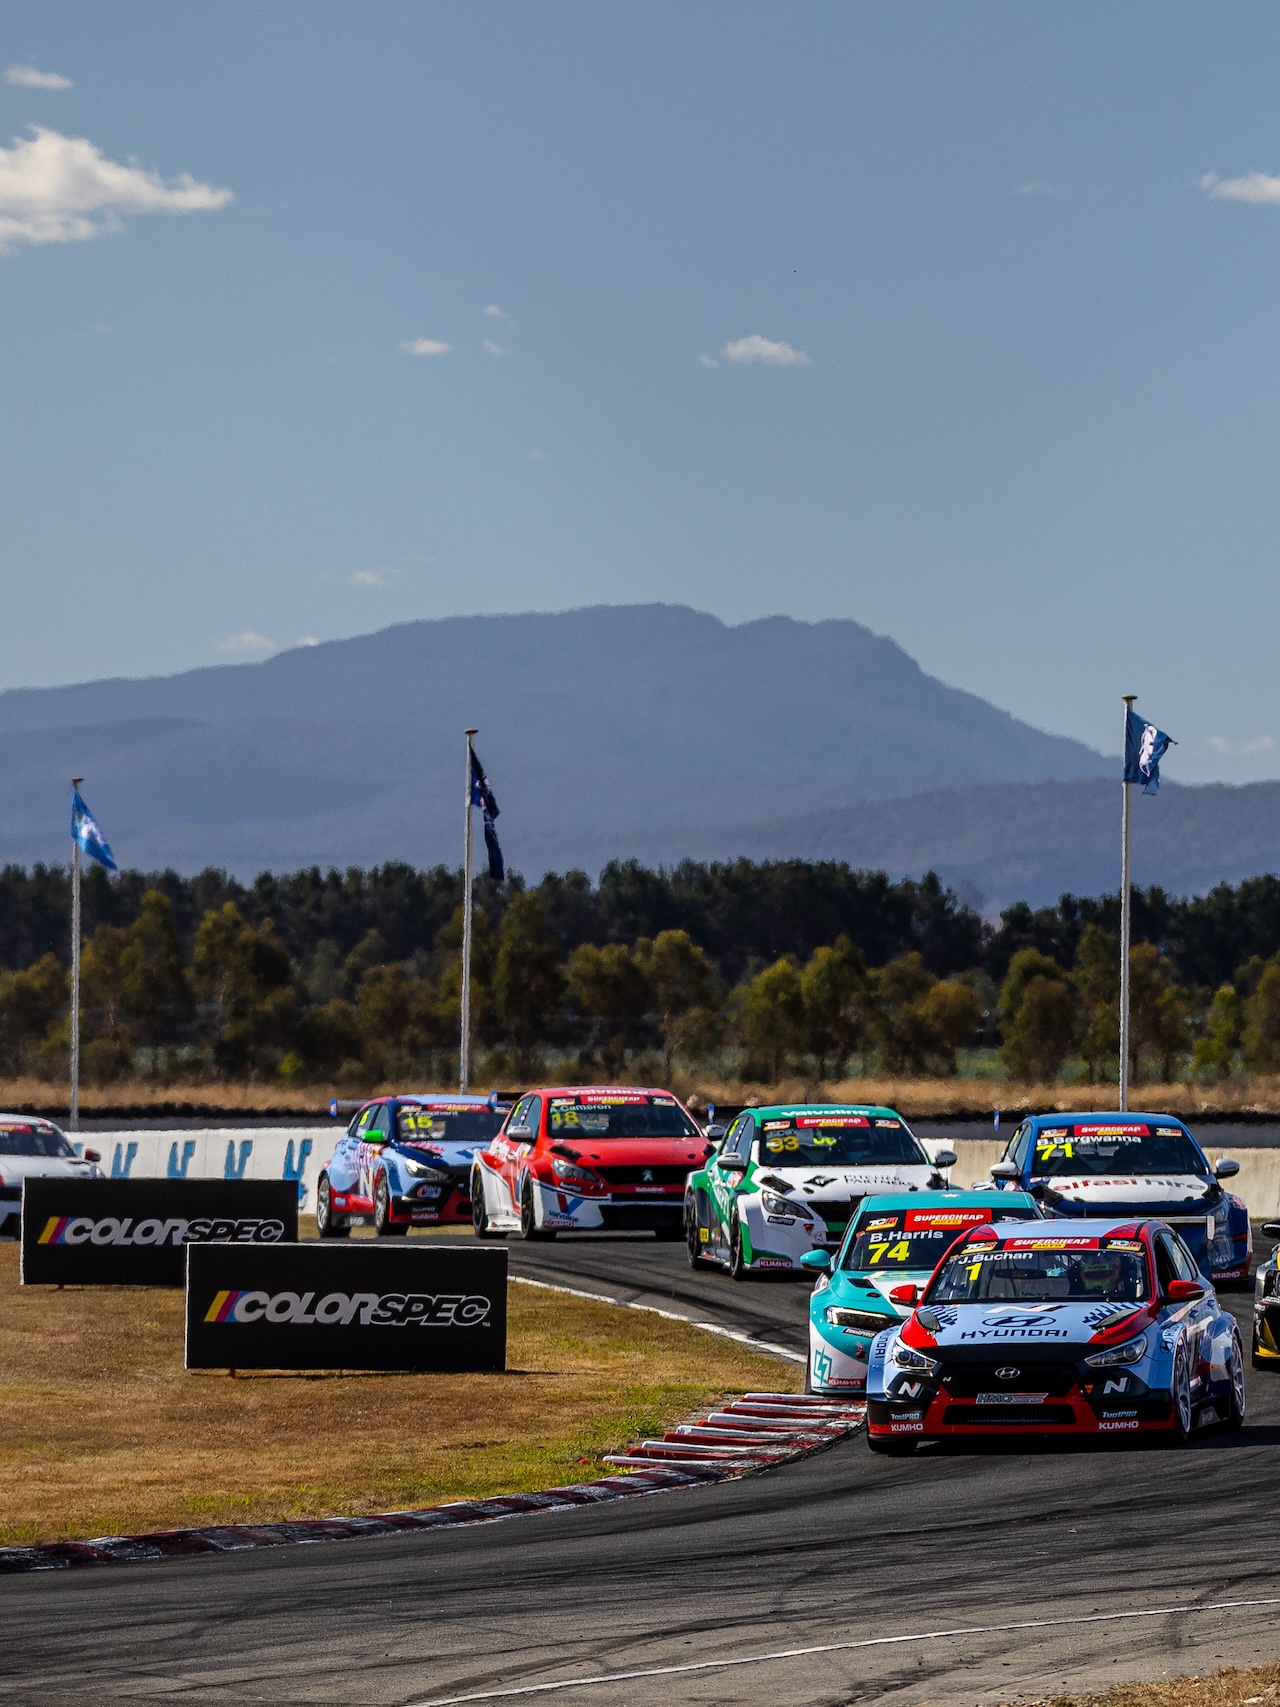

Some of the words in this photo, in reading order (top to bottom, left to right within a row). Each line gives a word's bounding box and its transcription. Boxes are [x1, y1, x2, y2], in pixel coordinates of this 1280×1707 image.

[403, 1115, 434, 1129] 15
[551, 1111, 579, 1126] 18
[768, 1136, 800, 1153] 33
[1037, 1135, 1142, 1147] B.Bargwanna
[1036, 1143, 1073, 1161] 71
[1053, 1177, 1138, 1192] alfasi
[1145, 1178, 1206, 1191] hire
[913, 1214, 984, 1222] SUPERCHEAP
[65, 1217, 286, 1246] COLORSPEC
[870, 1230, 944, 1243] B.Harris
[1013, 1238, 1091, 1246] SUPERCHEAP
[868, 1241, 911, 1265] 74
[958, 1252, 1033, 1265] J.Buchan
[759, 1261, 792, 1269] KUMHO
[965, 1263, 982, 1281] 1
[235, 1292, 491, 1327] COLORSPEC
[960, 1329, 1068, 1340] HYUNDAI
[891, 1412, 920, 1420] ToolPRO
[1102, 1410, 1138, 1418] ToolPRO
[890, 1423, 924, 1432] KUMHO
[1099, 1421, 1139, 1430] KUMHO
